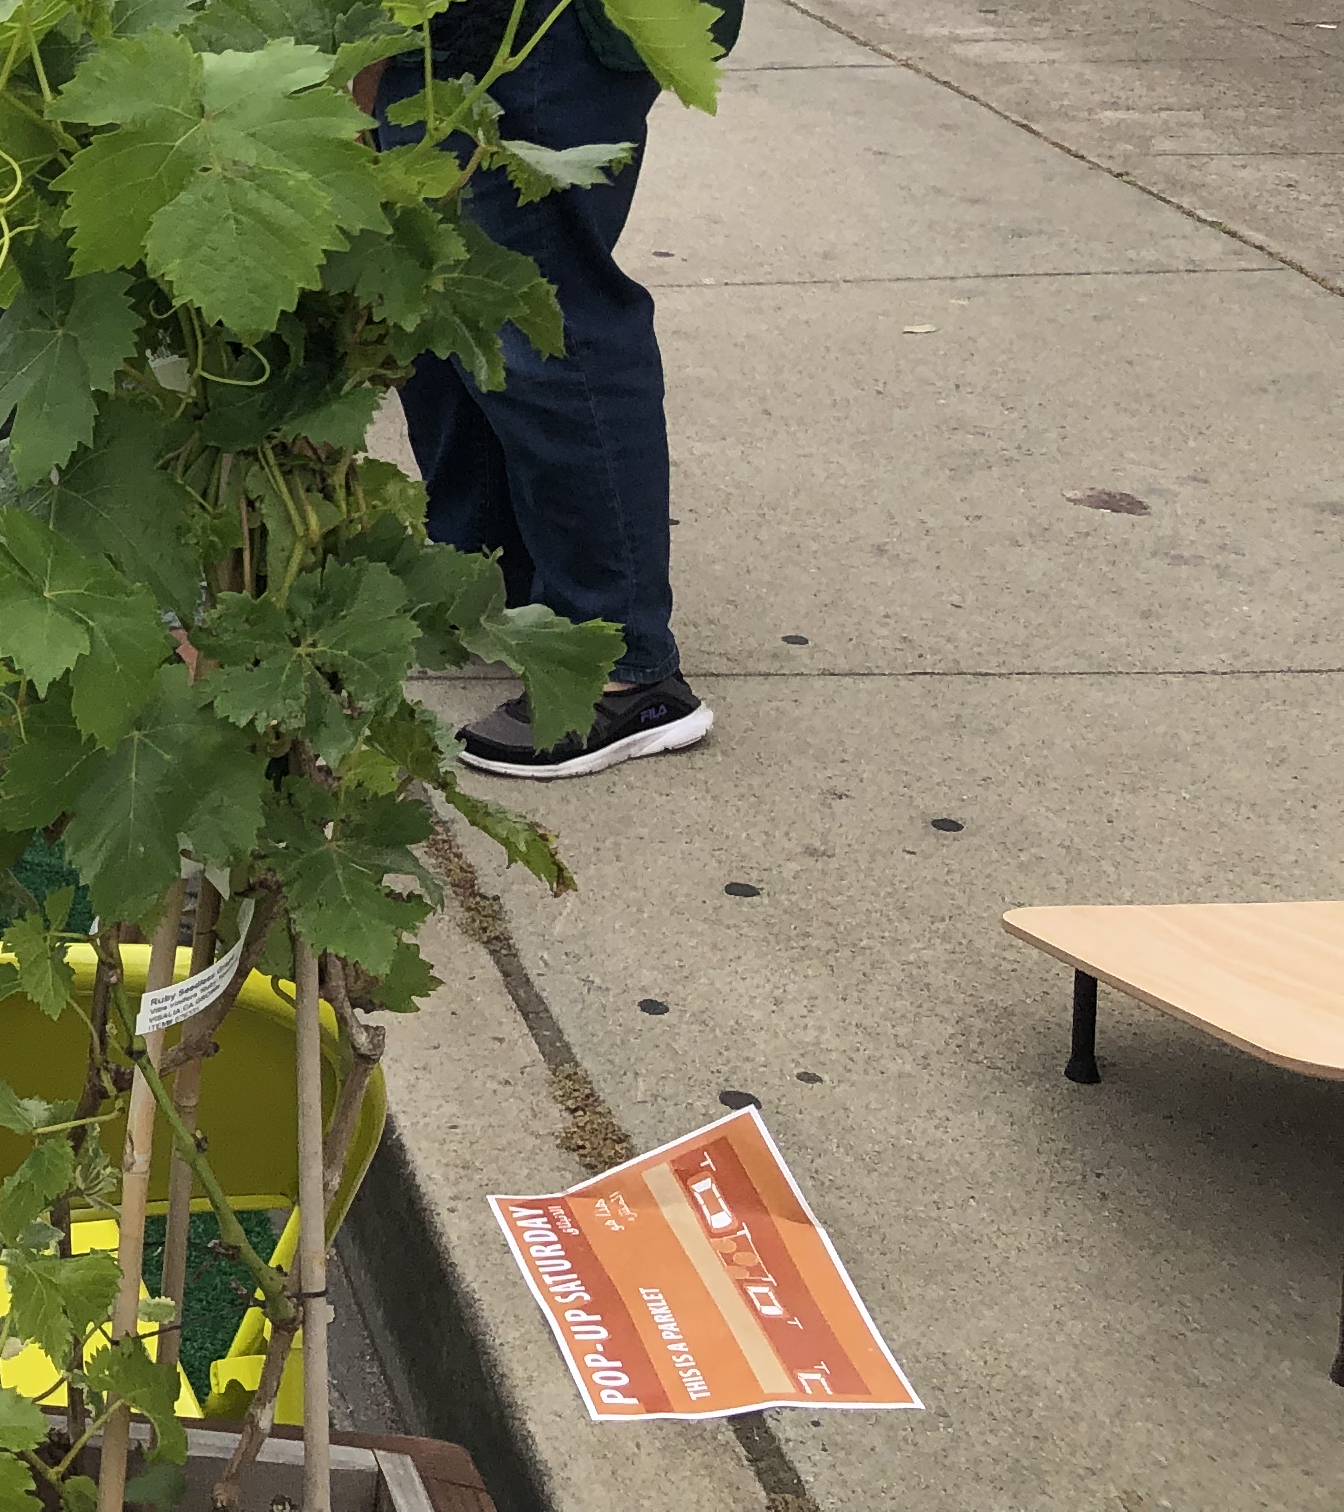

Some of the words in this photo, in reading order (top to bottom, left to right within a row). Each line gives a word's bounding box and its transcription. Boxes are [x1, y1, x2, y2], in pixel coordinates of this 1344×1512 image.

[640, 704, 668, 723] FILA
[150, 993, 177, 1006] Ruby
[508, 1205, 592, 1304] SATURDAY
[638, 1287, 684, 1340] PARKLET
[564, 1308, 641, 1406] POP-UP
[666, 1341, 689, 1353] A
[671, 1354, 697, 1369] IS
[677, 1368, 711, 1401] THIS
